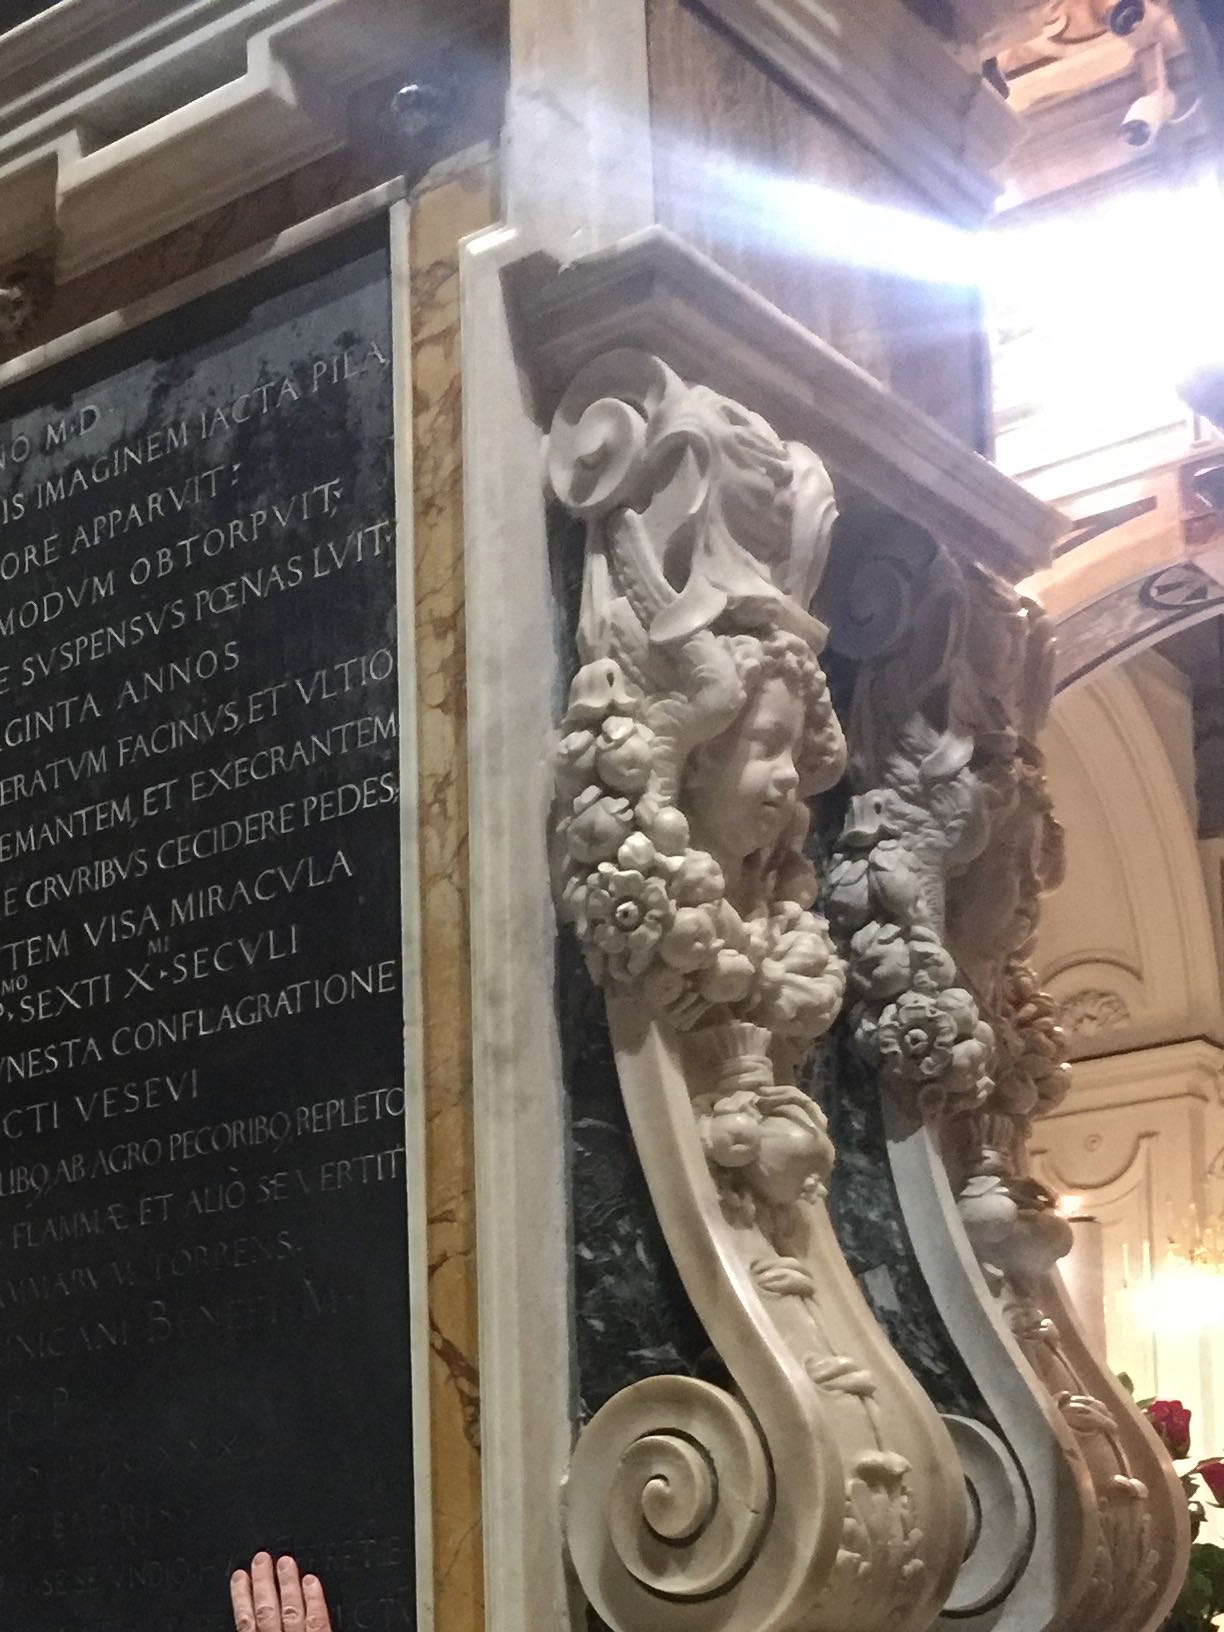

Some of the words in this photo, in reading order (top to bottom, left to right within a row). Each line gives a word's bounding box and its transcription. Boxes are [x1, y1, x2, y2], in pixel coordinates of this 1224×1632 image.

[36, 422, 188, 510] IMAGINEM
[201, 377, 300, 440] IACTA
[0, 533, 61, 580] ORE
[21, 598, 186, 687] SVSPENSVS
[115, 640, 241, 710] ANNOS
[248, 682, 288, 725] ET
[295, 648, 394, 705] VLTIO
[142, 778, 179, 817] ET
[190, 711, 397, 802] EXECRANTEM
[26, 848, 148, 909] CRVRIBVS
[156, 803, 297, 870] CECIDERE
[83, 904, 160, 947] VISA
[169, 850, 353, 928] MIRACVLA
[20, 973, 112, 1024] SEXTI
[111, 959, 397, 1057] CONFLAGRATIONE
[75, 1068, 199, 1123] VESEVI
[54, 1152, 87, 1184] AB
[90, 1137, 163, 1179] AGRO
[139, 1192, 174, 1226] ET
